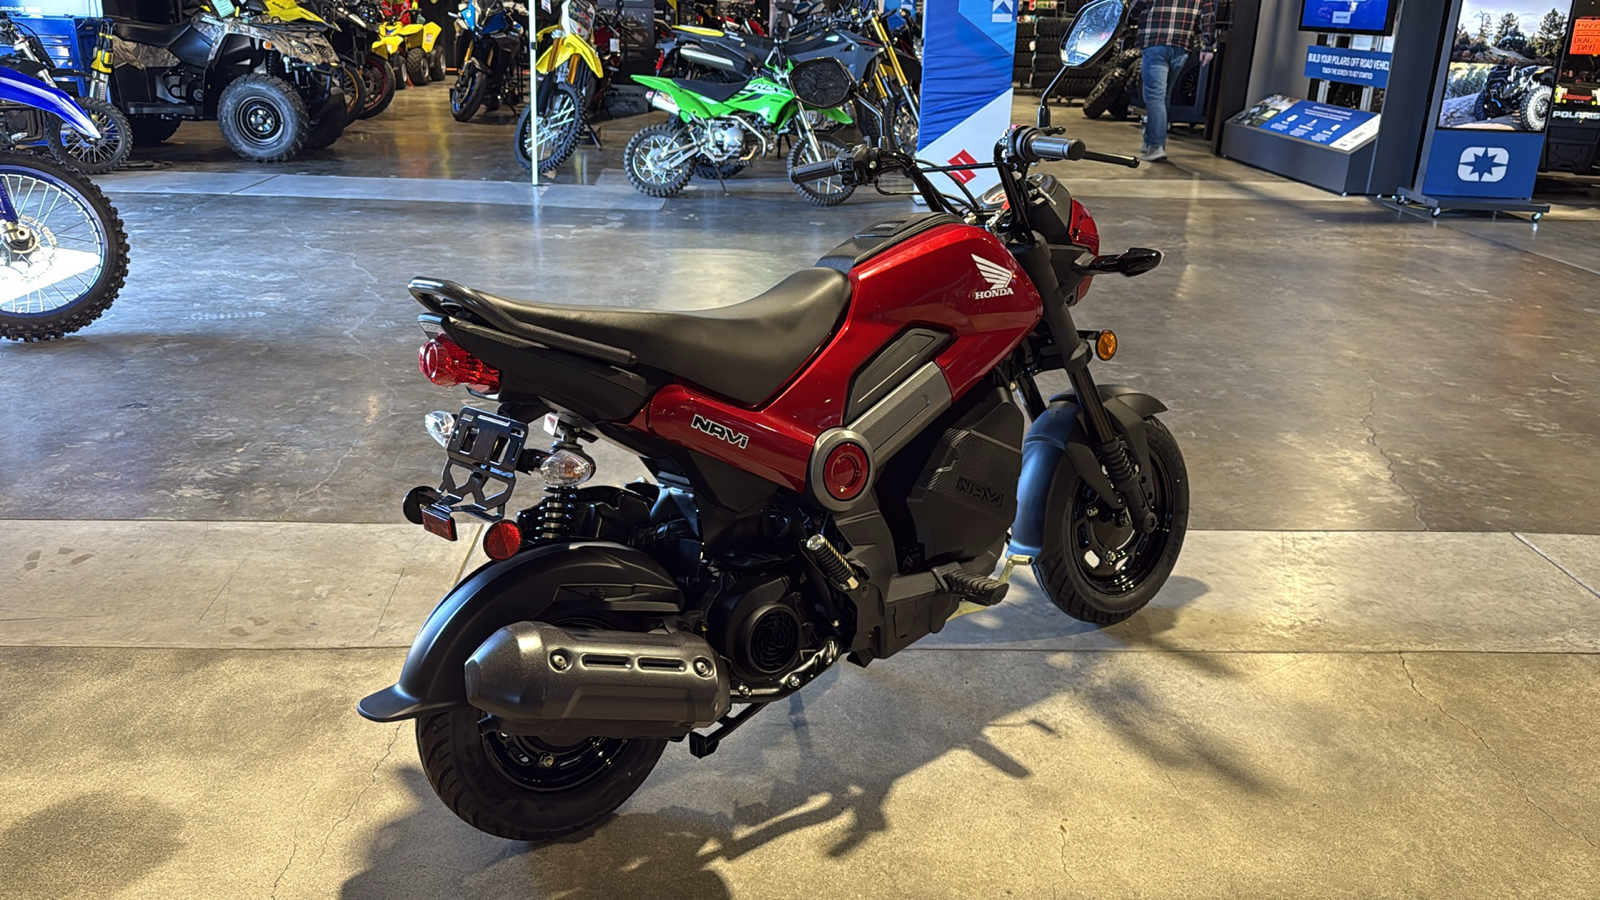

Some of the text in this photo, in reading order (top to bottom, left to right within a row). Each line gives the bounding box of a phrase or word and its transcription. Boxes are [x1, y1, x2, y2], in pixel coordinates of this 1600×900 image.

[1307, 53, 1390, 71] BUILD YOUR POLARIS OFF ROAD VEHICL
[1552, 111, 1600, 119] POLARIS
[975, 288, 1014, 300] HONDA
